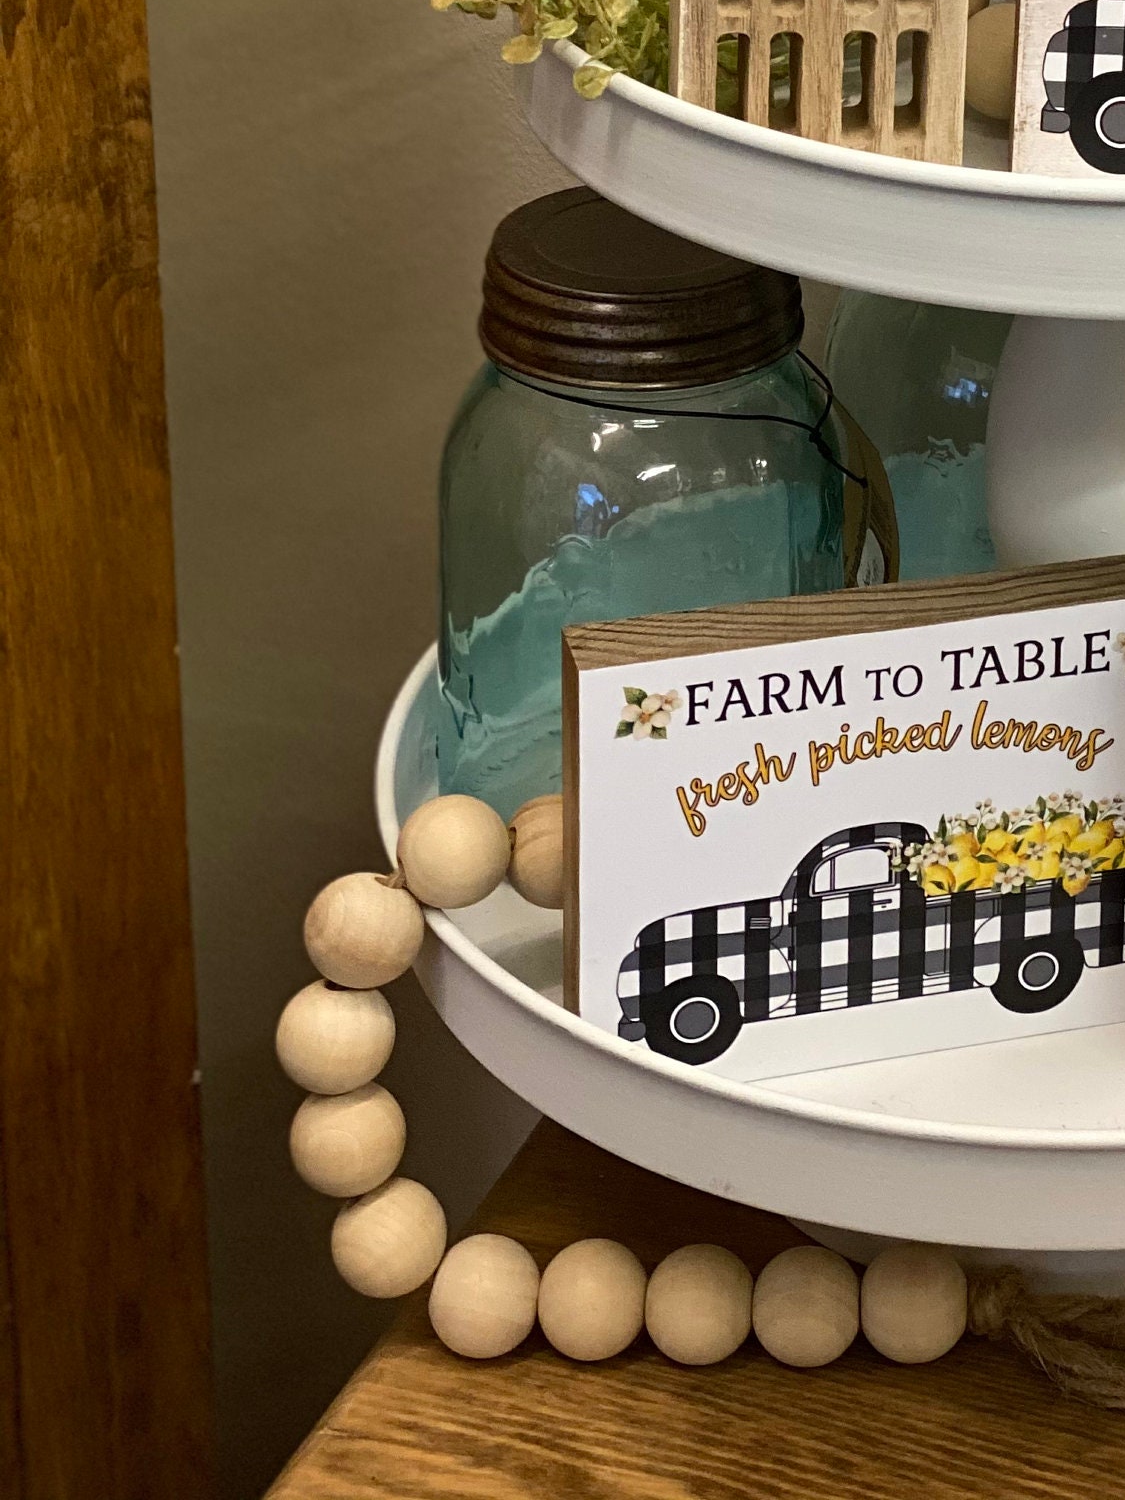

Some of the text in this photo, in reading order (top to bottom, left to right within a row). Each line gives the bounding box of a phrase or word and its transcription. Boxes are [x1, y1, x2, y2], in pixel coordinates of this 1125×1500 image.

[685, 629, 1113, 726] FARM TO TABLE
[676, 700, 1115, 837] fresh picked lemons
